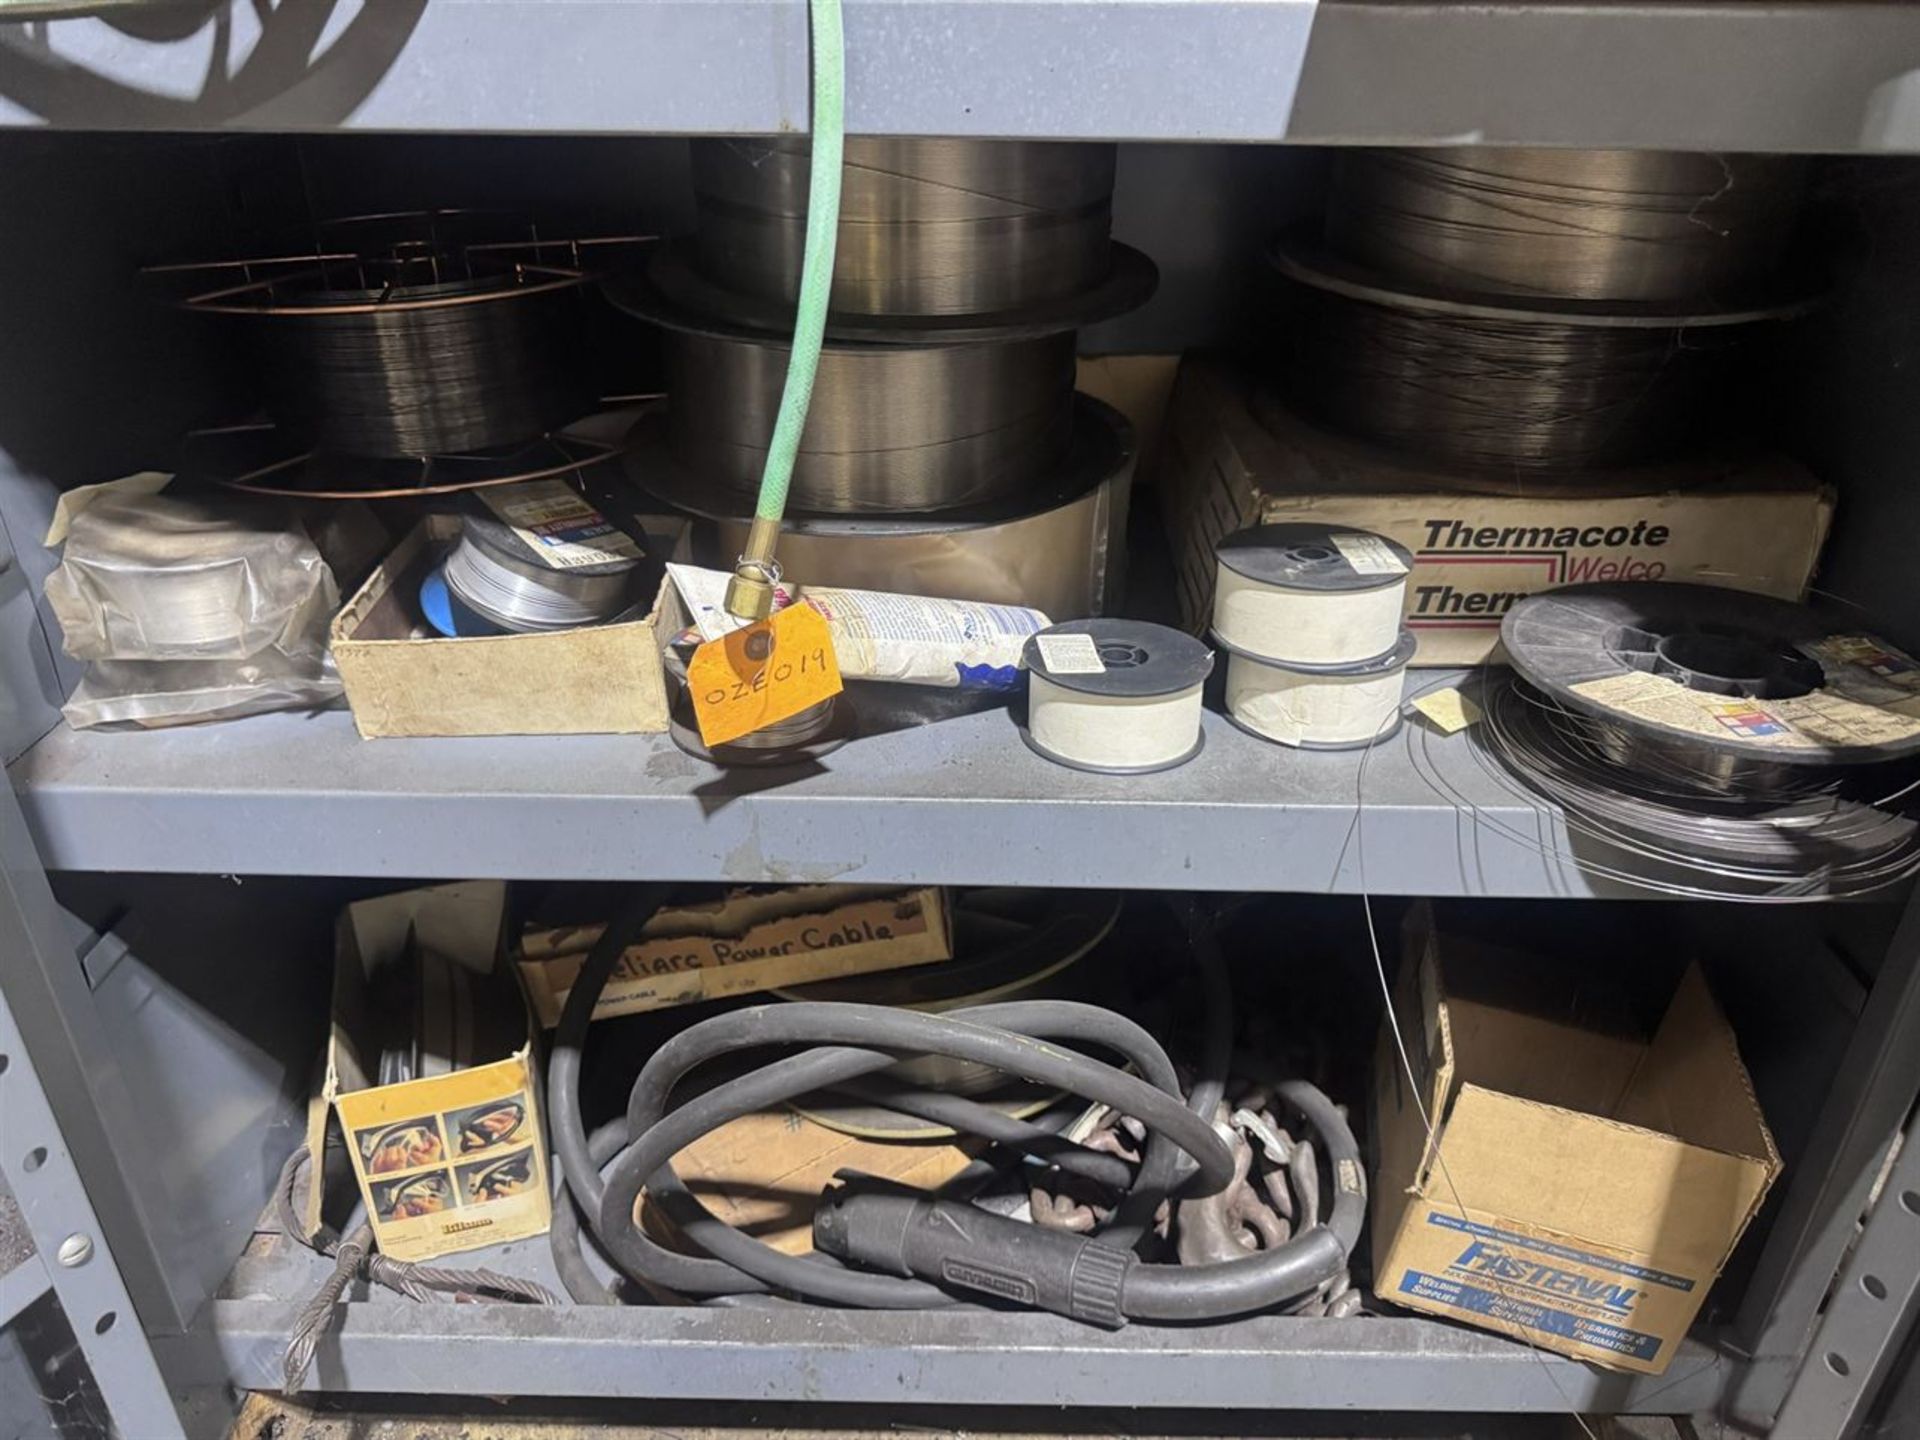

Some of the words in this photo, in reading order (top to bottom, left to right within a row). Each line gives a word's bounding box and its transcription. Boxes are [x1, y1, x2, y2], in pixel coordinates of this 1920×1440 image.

[1424, 519, 1669, 548] Thermacote
[1567, 556, 1666, 582] Welco
[608, 951, 702, 979] eliarc
[712, 938, 794, 967] Power
[801, 922, 895, 953] Cable
[1418, 1274, 1463, 1294] WELDING
[1456, 1241, 1638, 1305] FASTENAL
